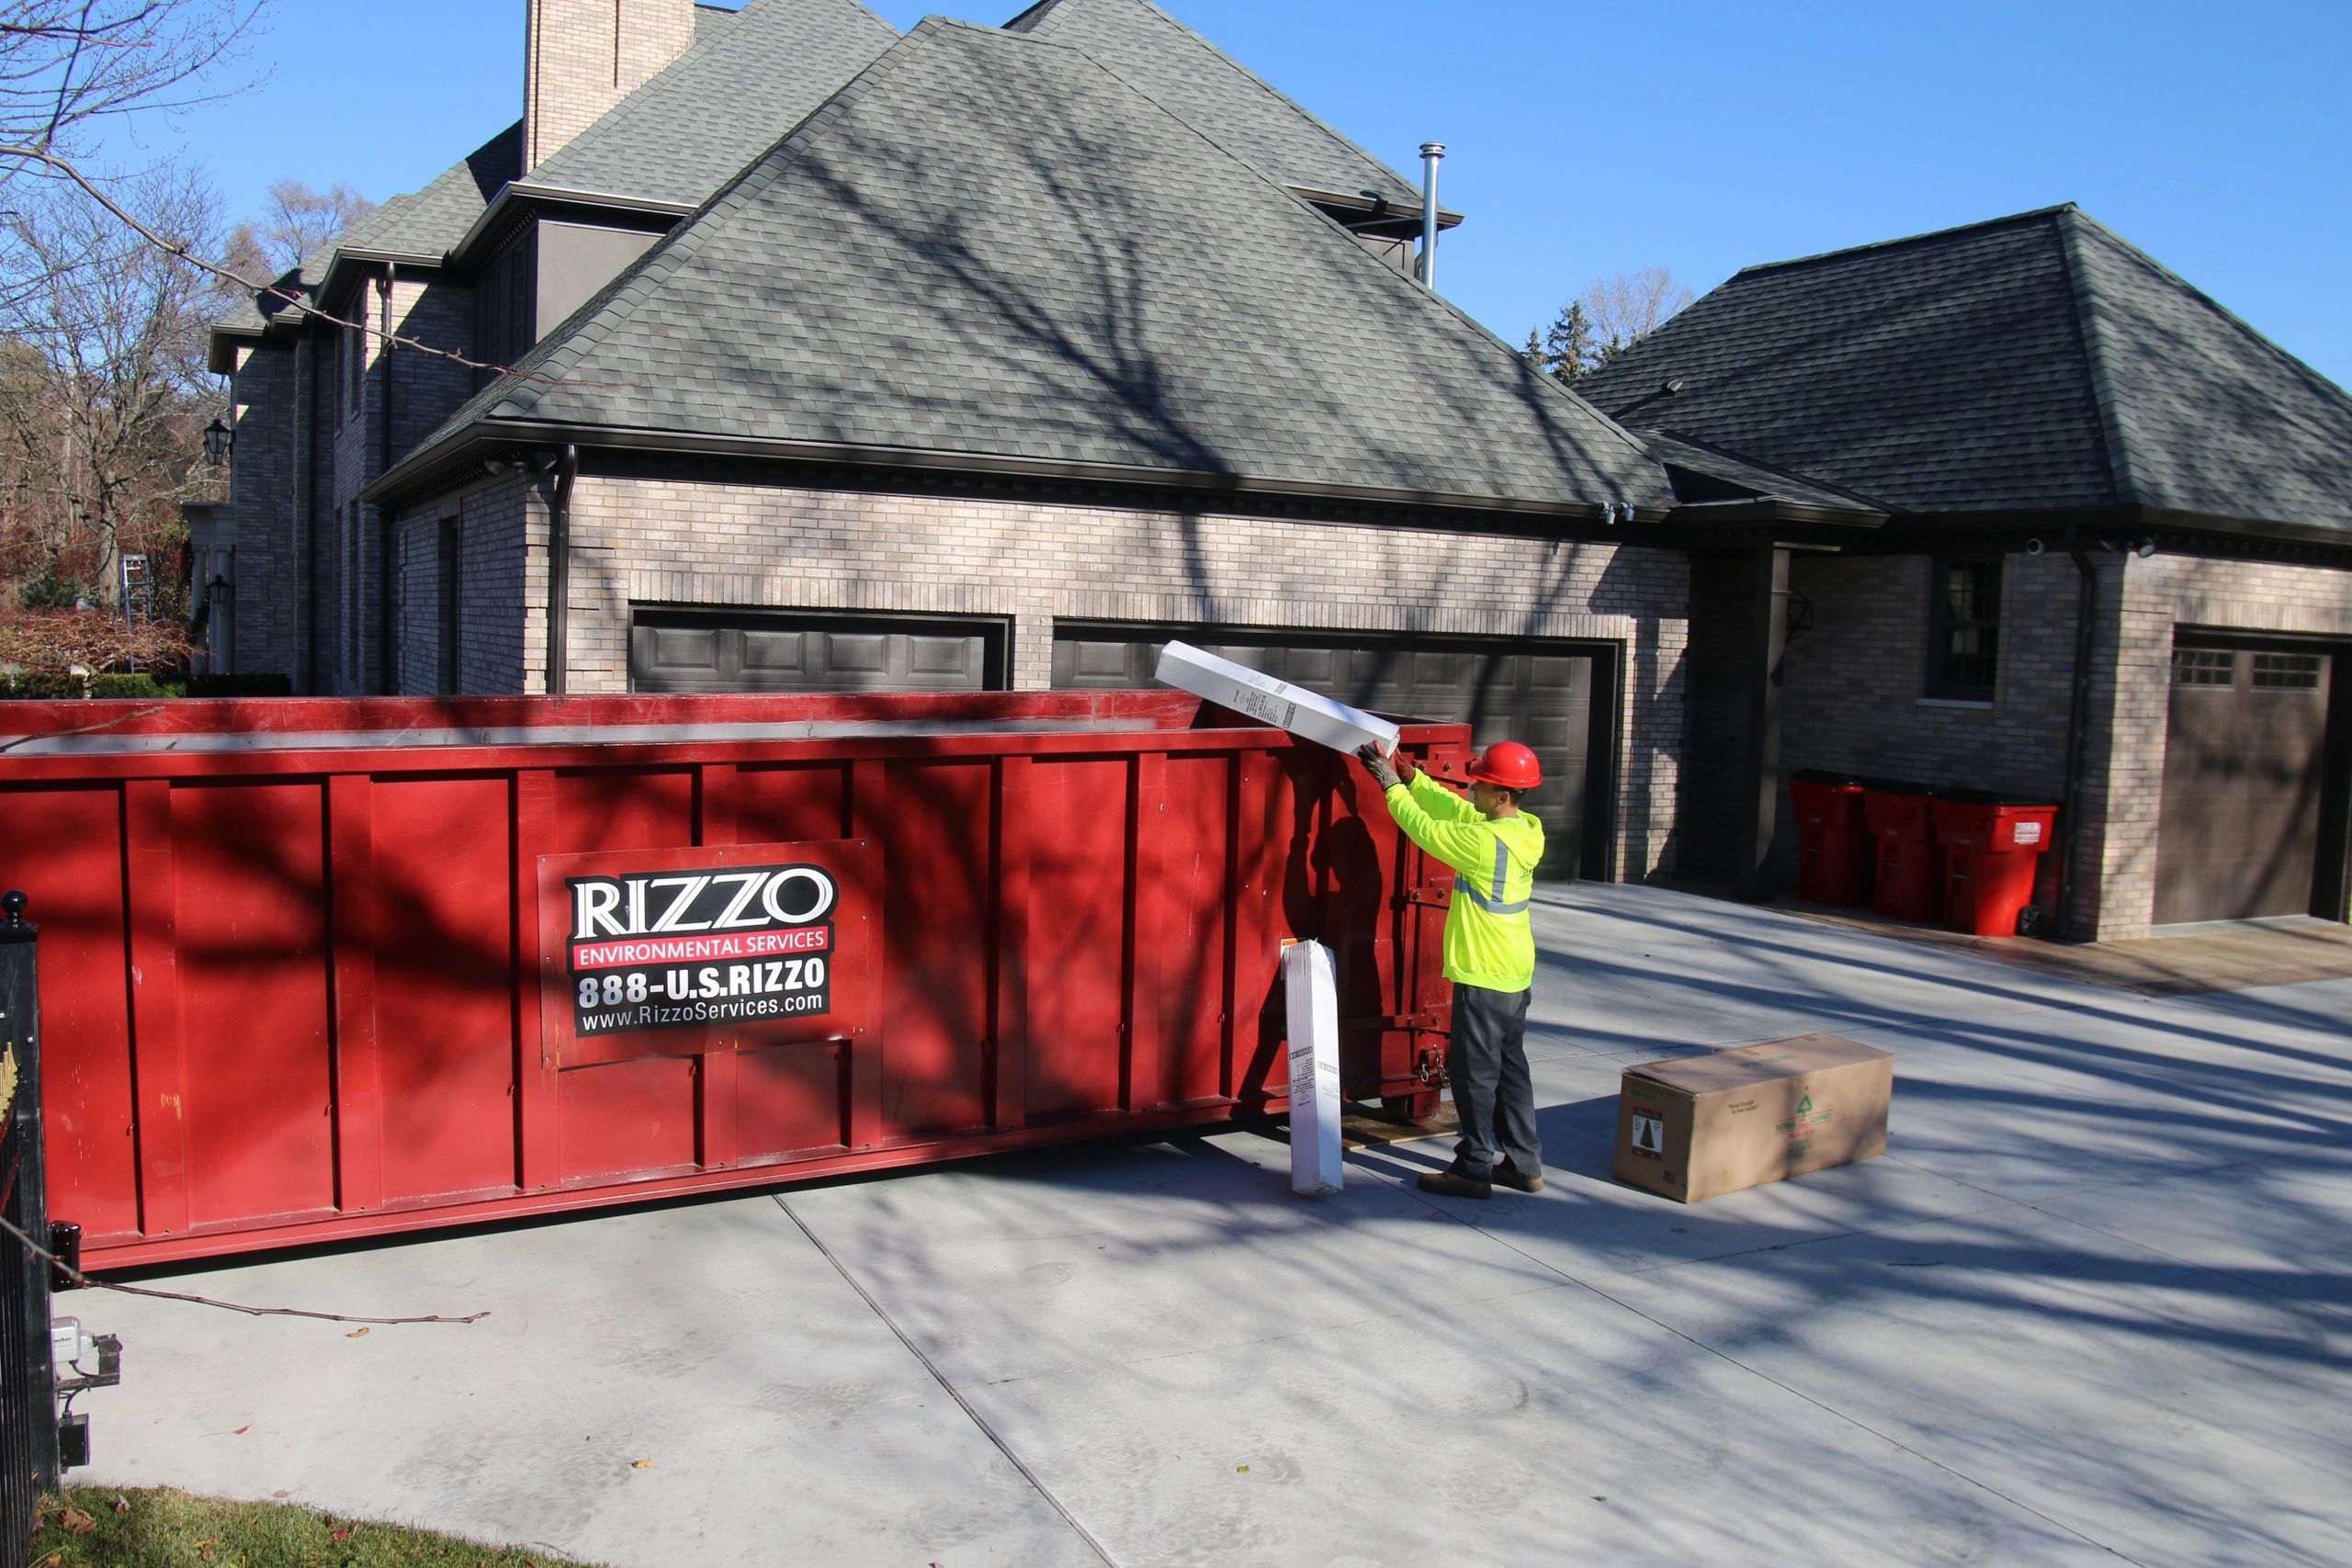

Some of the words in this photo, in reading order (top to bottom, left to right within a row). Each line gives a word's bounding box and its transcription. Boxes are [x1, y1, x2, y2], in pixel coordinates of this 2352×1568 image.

[574, 868, 833, 939] RIZZO
[580, 939, 742, 965] ENVIRONMENTAL
[747, 931, 824, 953] SERVICES
[579, 958, 825, 1009] 888-U.S.RIZZO
[582, 994, 822, 1031] www.RizzoServices.com
